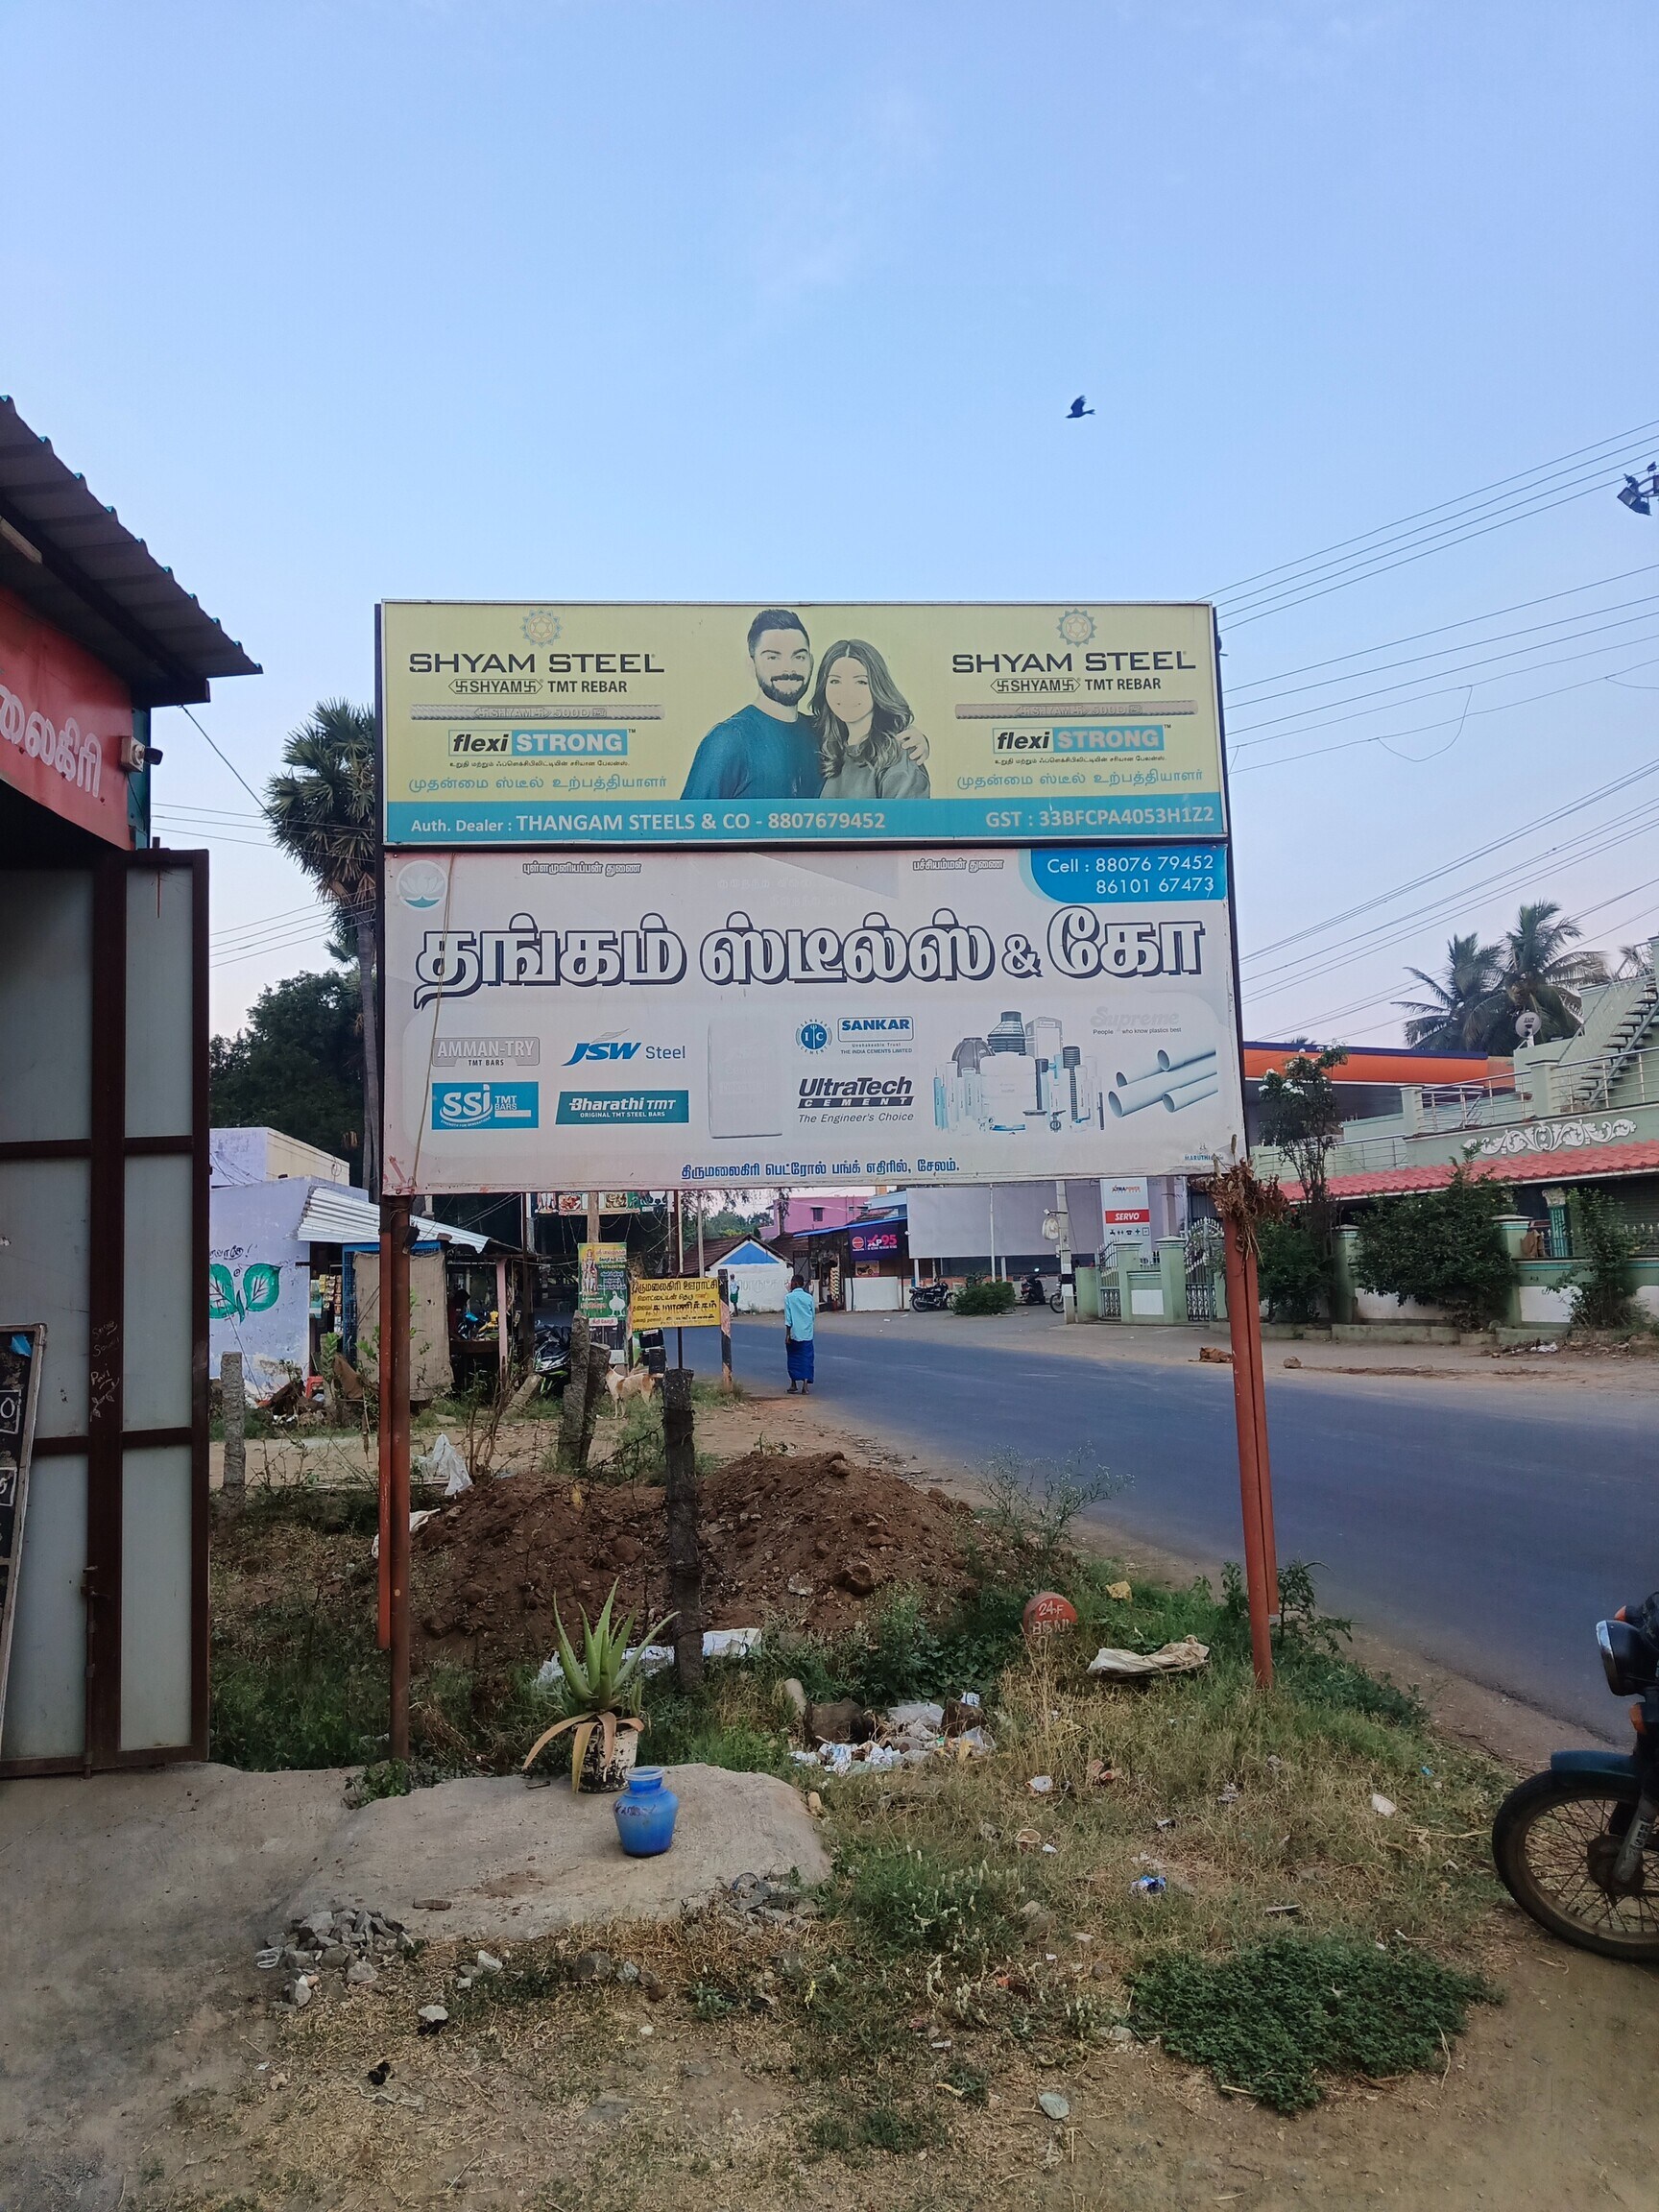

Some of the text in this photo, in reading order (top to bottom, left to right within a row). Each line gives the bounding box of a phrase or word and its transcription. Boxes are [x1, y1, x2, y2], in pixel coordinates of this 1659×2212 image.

[409, 653, 664, 673] SHYAM STEEL
[952, 651, 1196, 673] SHYAM STEEL
[469, 681, 627, 693] SHYAM TMT REBAR
[1011, 678, 1161, 692] SHYAM TMT REBAR
[453, 733, 622, 753] flexi STRONG
[997, 729, 1159, 750] flexi STRONG
[409, 773, 667, 793] முதன்மை ஸ்டீல் உற்பத்தியாளர்
[957, 768, 1203, 790] முதன்மை ஸ்டீல் உற்பத்தியாளர்
[411, 820, 451, 831] Auth.
[456, 819, 503, 831] Dealer
[517, 814, 622, 831] THANGAM
[629, 813, 695, 830] STEELS
[701, 813, 716, 830] &
[723, 813, 750, 830] CO
[768, 812, 885, 830] 8807679452
[986, 811, 1022, 828] GST
[1040, 805, 1214, 827] 33BFCPA4053H1Z2
[605, 863, 641, 877] துணை
[913, 857, 1004, 873] பச்சியம்மன் துணை
[1047, 858, 1078, 874] Cell
[1095, 856, 1151, 873] 88076
[1157, 854, 1214, 871] 79452
[1096, 877, 1214, 895] 86101 67473
[414, 903, 1206, 1010] தங்கம் ஸ்டீல்ஸ் & கோ
[842, 1019, 910, 1031] SANKAR
[437, 1040, 535, 1058] AMMAN-TRY
[561, 1043, 685, 1067] JSW Steel
[799, 1076, 912, 1096] UltraTech
[494, 1095, 517, 1104] TMT
[568, 1097, 676, 1111] Bharathi TMT
[805, 1097, 907, 1107] CEMENT
[799, 1112, 914, 1124] The Engineer's Choice
[681, 1157, 960, 1180] திருமலைகிரி பெட்ரோல் பங்க் எதிரில், சேலம்.
[1115, 1212, 1140, 1221] SERVO
